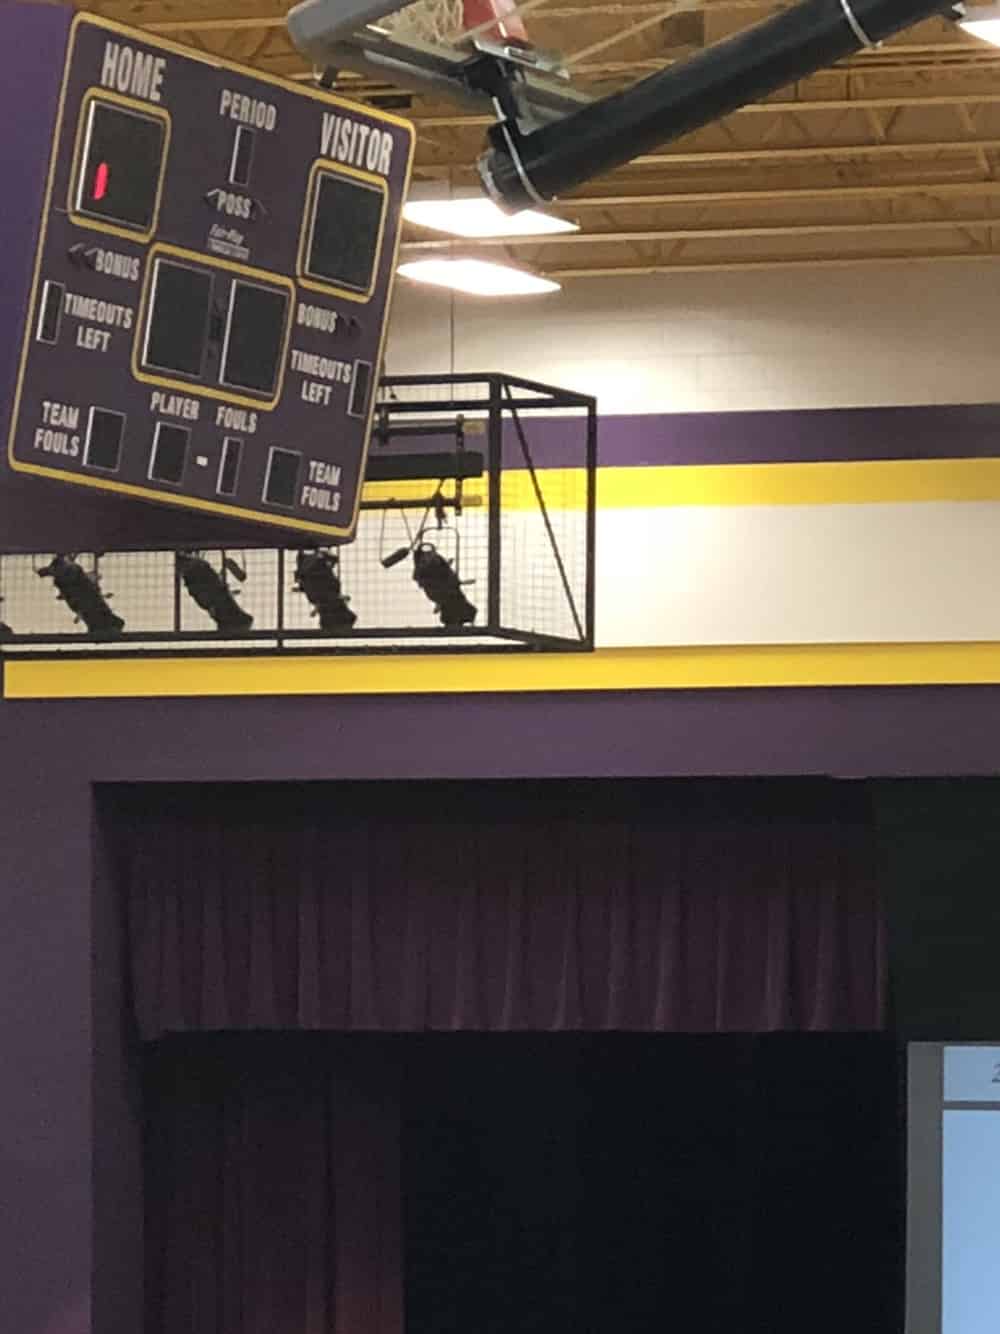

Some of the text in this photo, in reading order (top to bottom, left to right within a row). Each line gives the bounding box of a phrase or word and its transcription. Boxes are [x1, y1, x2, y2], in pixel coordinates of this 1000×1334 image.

[101, 40, 167, 101] HOME
[219, 89, 276, 130] PERIOD
[320, 112, 393, 176] VISITOR
[217, 191, 252, 219] POSS
[95, 248, 140, 281] BONUS
[65, 293, 134, 329] TIMEOUTS
[298, 303, 337, 334] BONUS
[76, 325, 111, 352] LEFT
[291, 349, 352, 384] TIMEOUTS
[302, 380, 333, 406] LEFT
[42, 401, 80, 430] TEAM
[150, 391, 257, 433] PLAYER FOULS
[34, 428, 80, 456] FOULS
[309, 460, 341, 486] TEAM
[301, 485, 341, 512] FOULS
